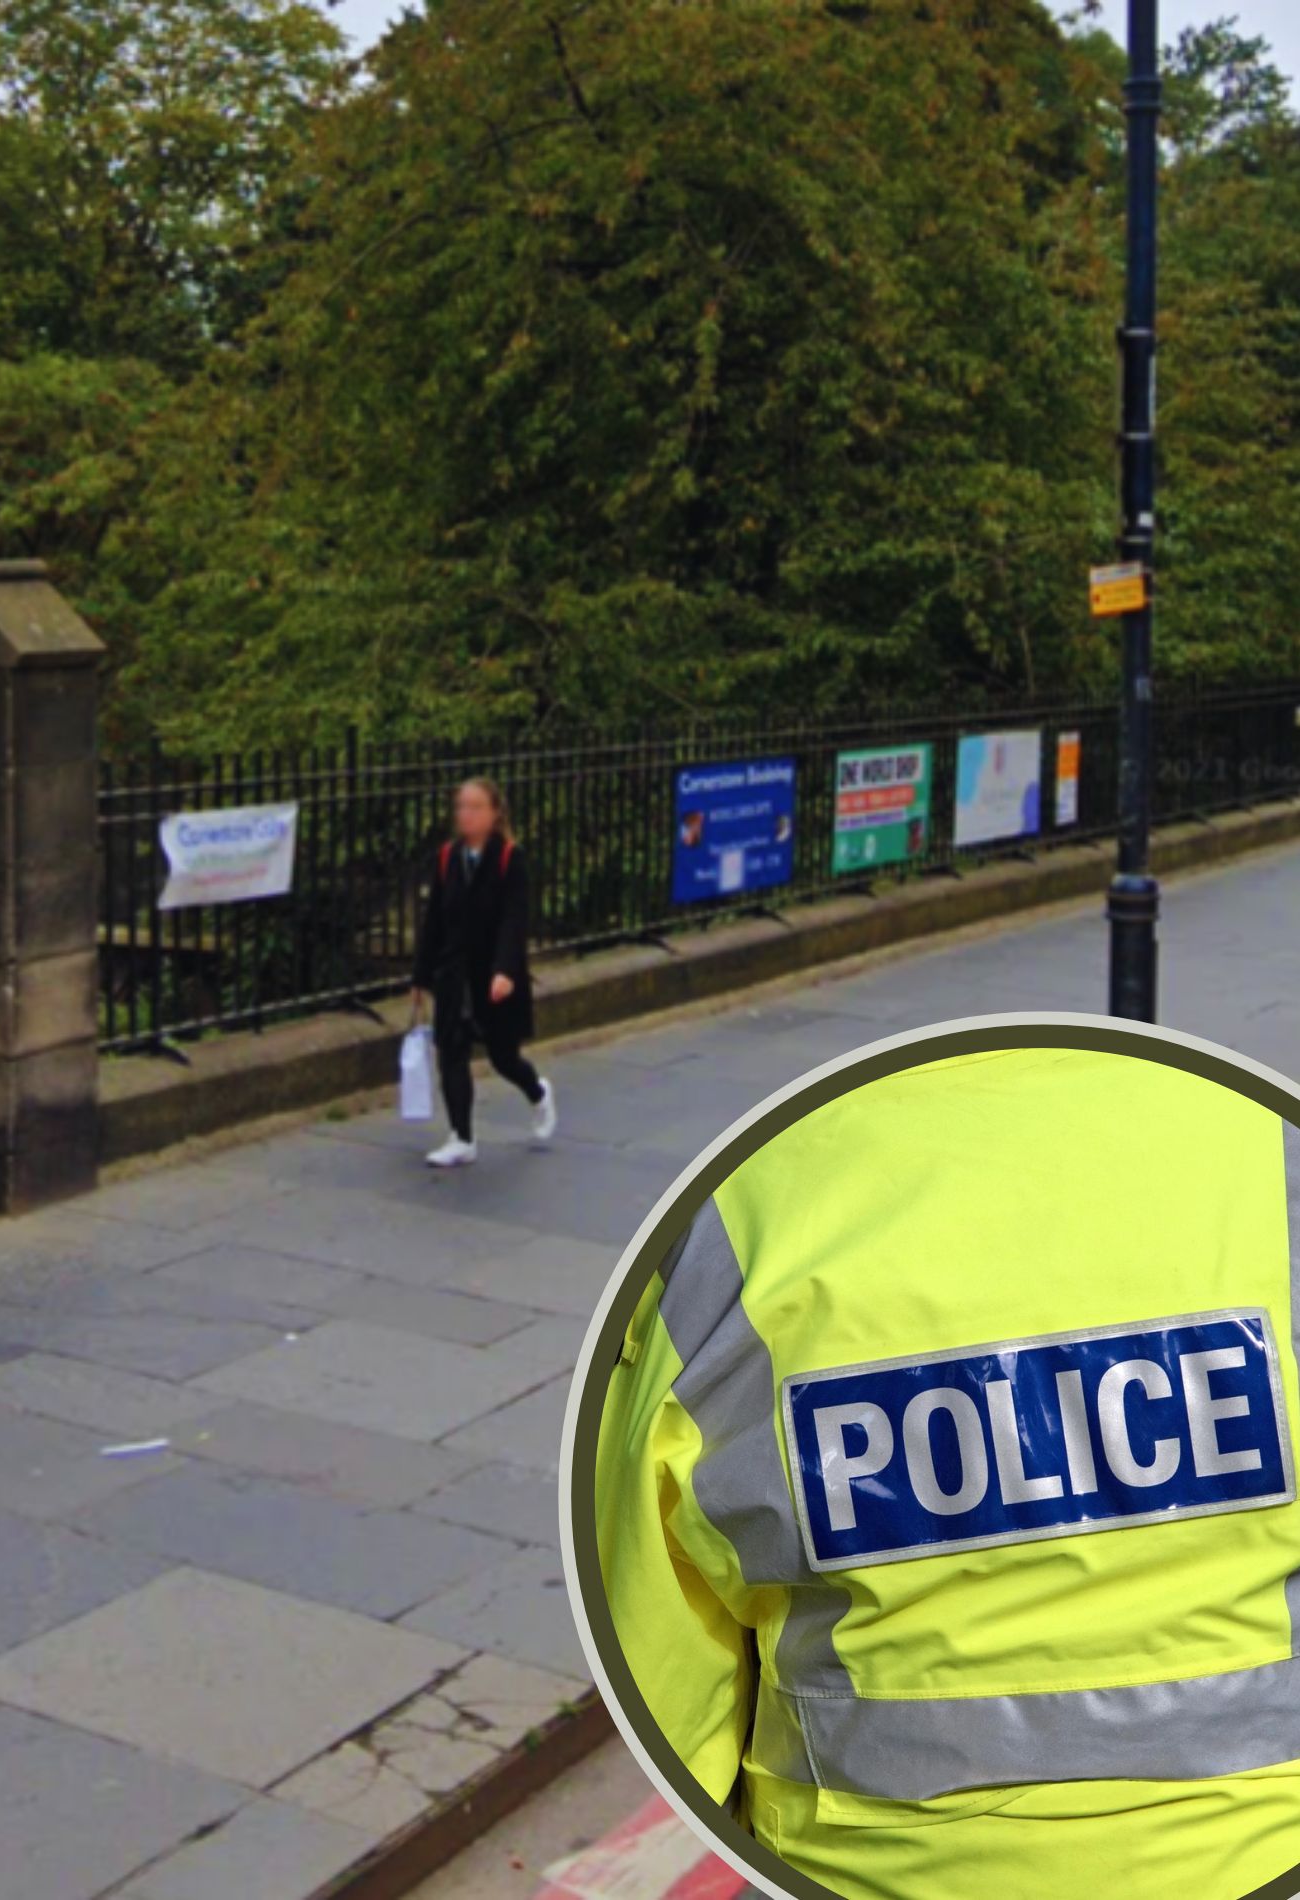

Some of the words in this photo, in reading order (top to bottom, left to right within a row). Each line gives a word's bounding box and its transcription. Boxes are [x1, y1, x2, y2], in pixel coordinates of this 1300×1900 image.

[839, 760, 858, 787] ONE
[861, 756, 895, 783] WORLD
[896, 752, 919, 780] SHOP
[813, 1345, 1262, 1532] POLICE
